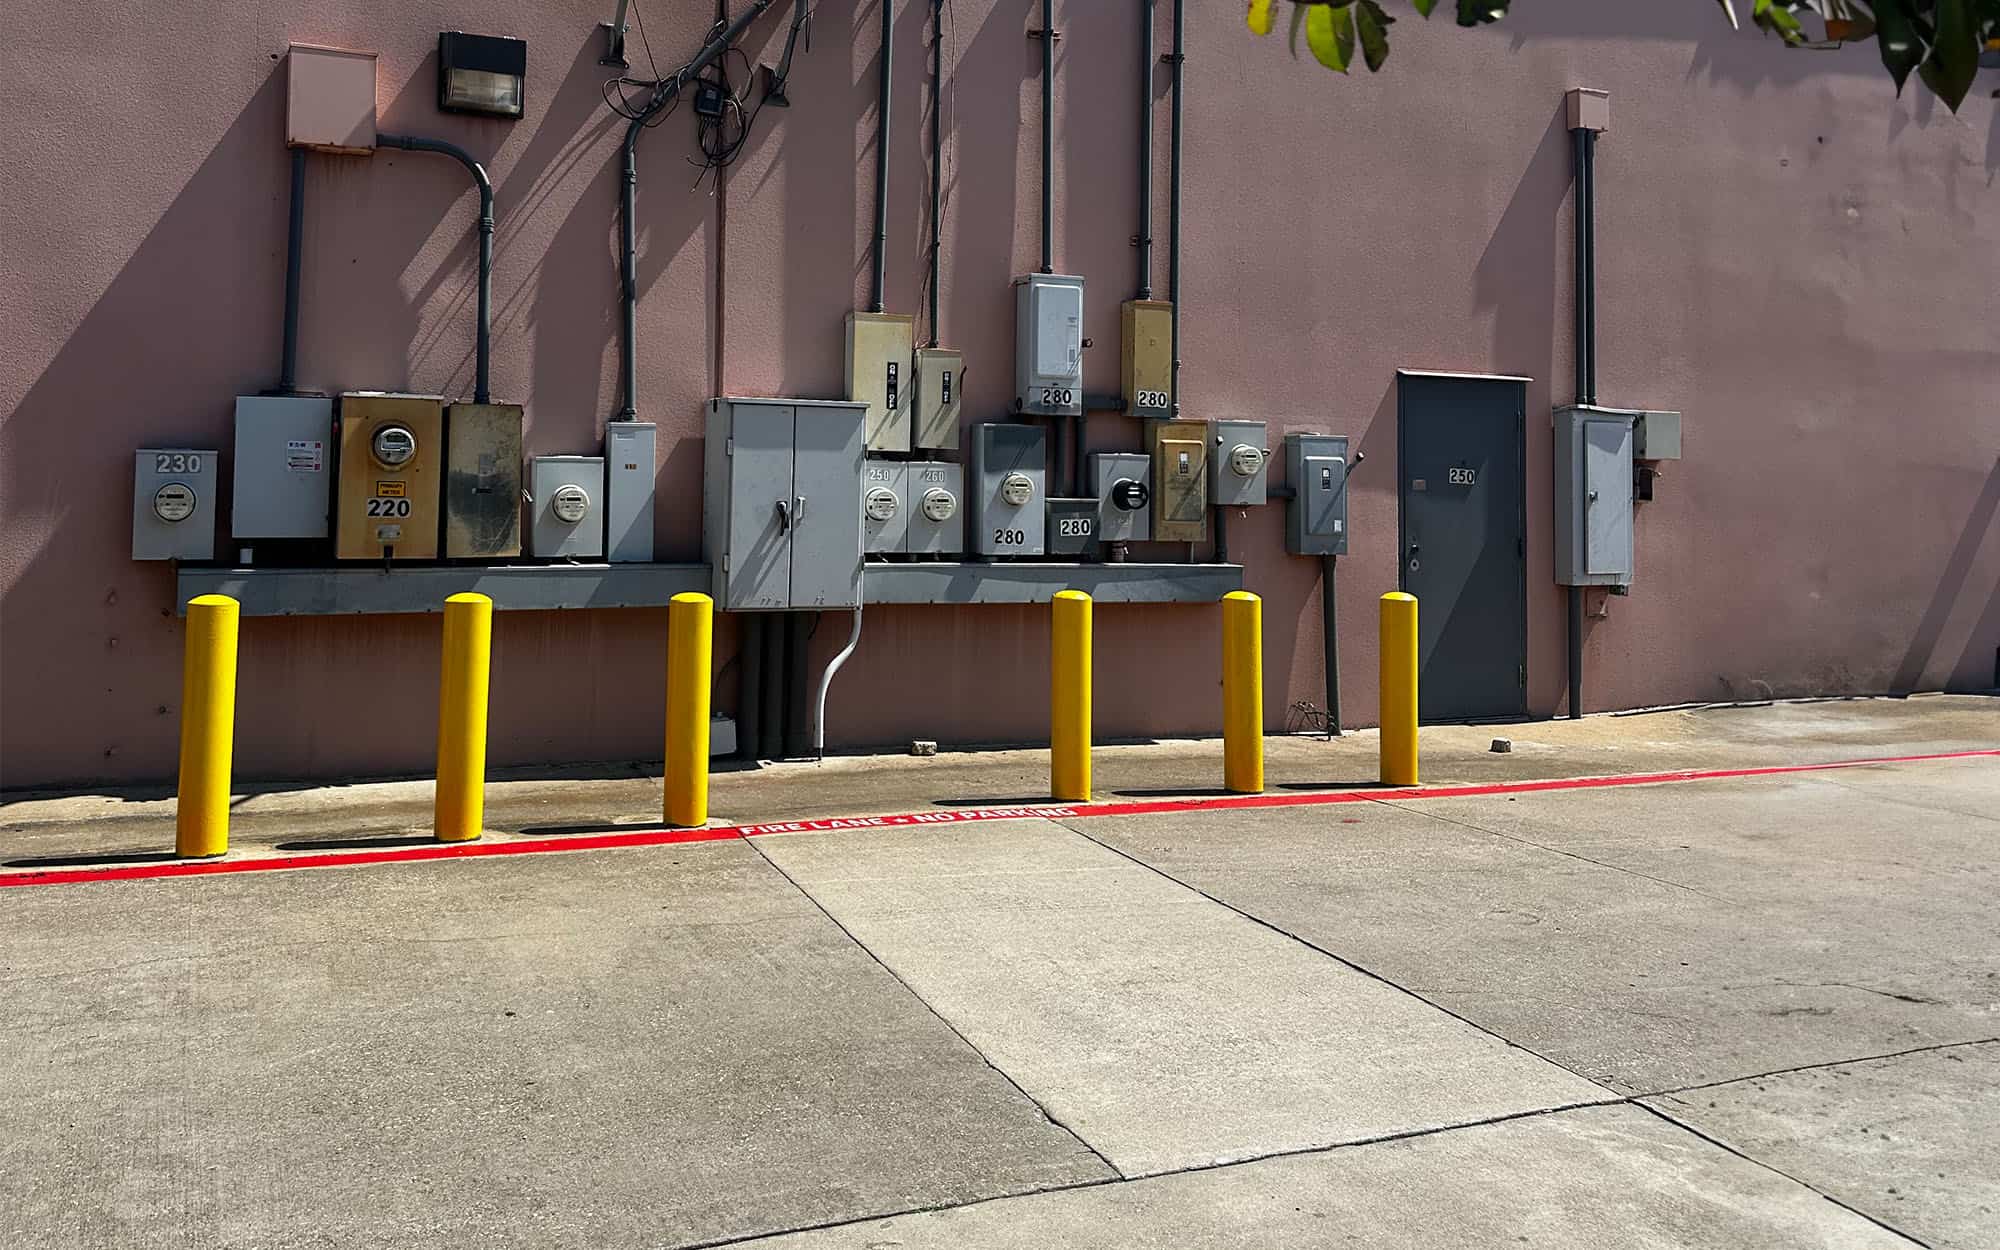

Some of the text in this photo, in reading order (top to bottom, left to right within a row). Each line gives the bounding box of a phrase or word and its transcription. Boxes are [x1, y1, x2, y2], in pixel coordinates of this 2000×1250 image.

[1043, 389, 1072, 404] 280
[1139, 391, 1167, 407] 280
[157, 453, 201, 473] 230
[870, 469, 889, 481] 250
[926, 471, 945, 482] 260
[1450, 469, 1474, 483] 250
[367, 499, 410, 517] 220
[1061, 519, 1090, 535] 280
[994, 528, 1025, 545] 280
[739, 807, 1078, 835] FIRE LANE NO PARKING
